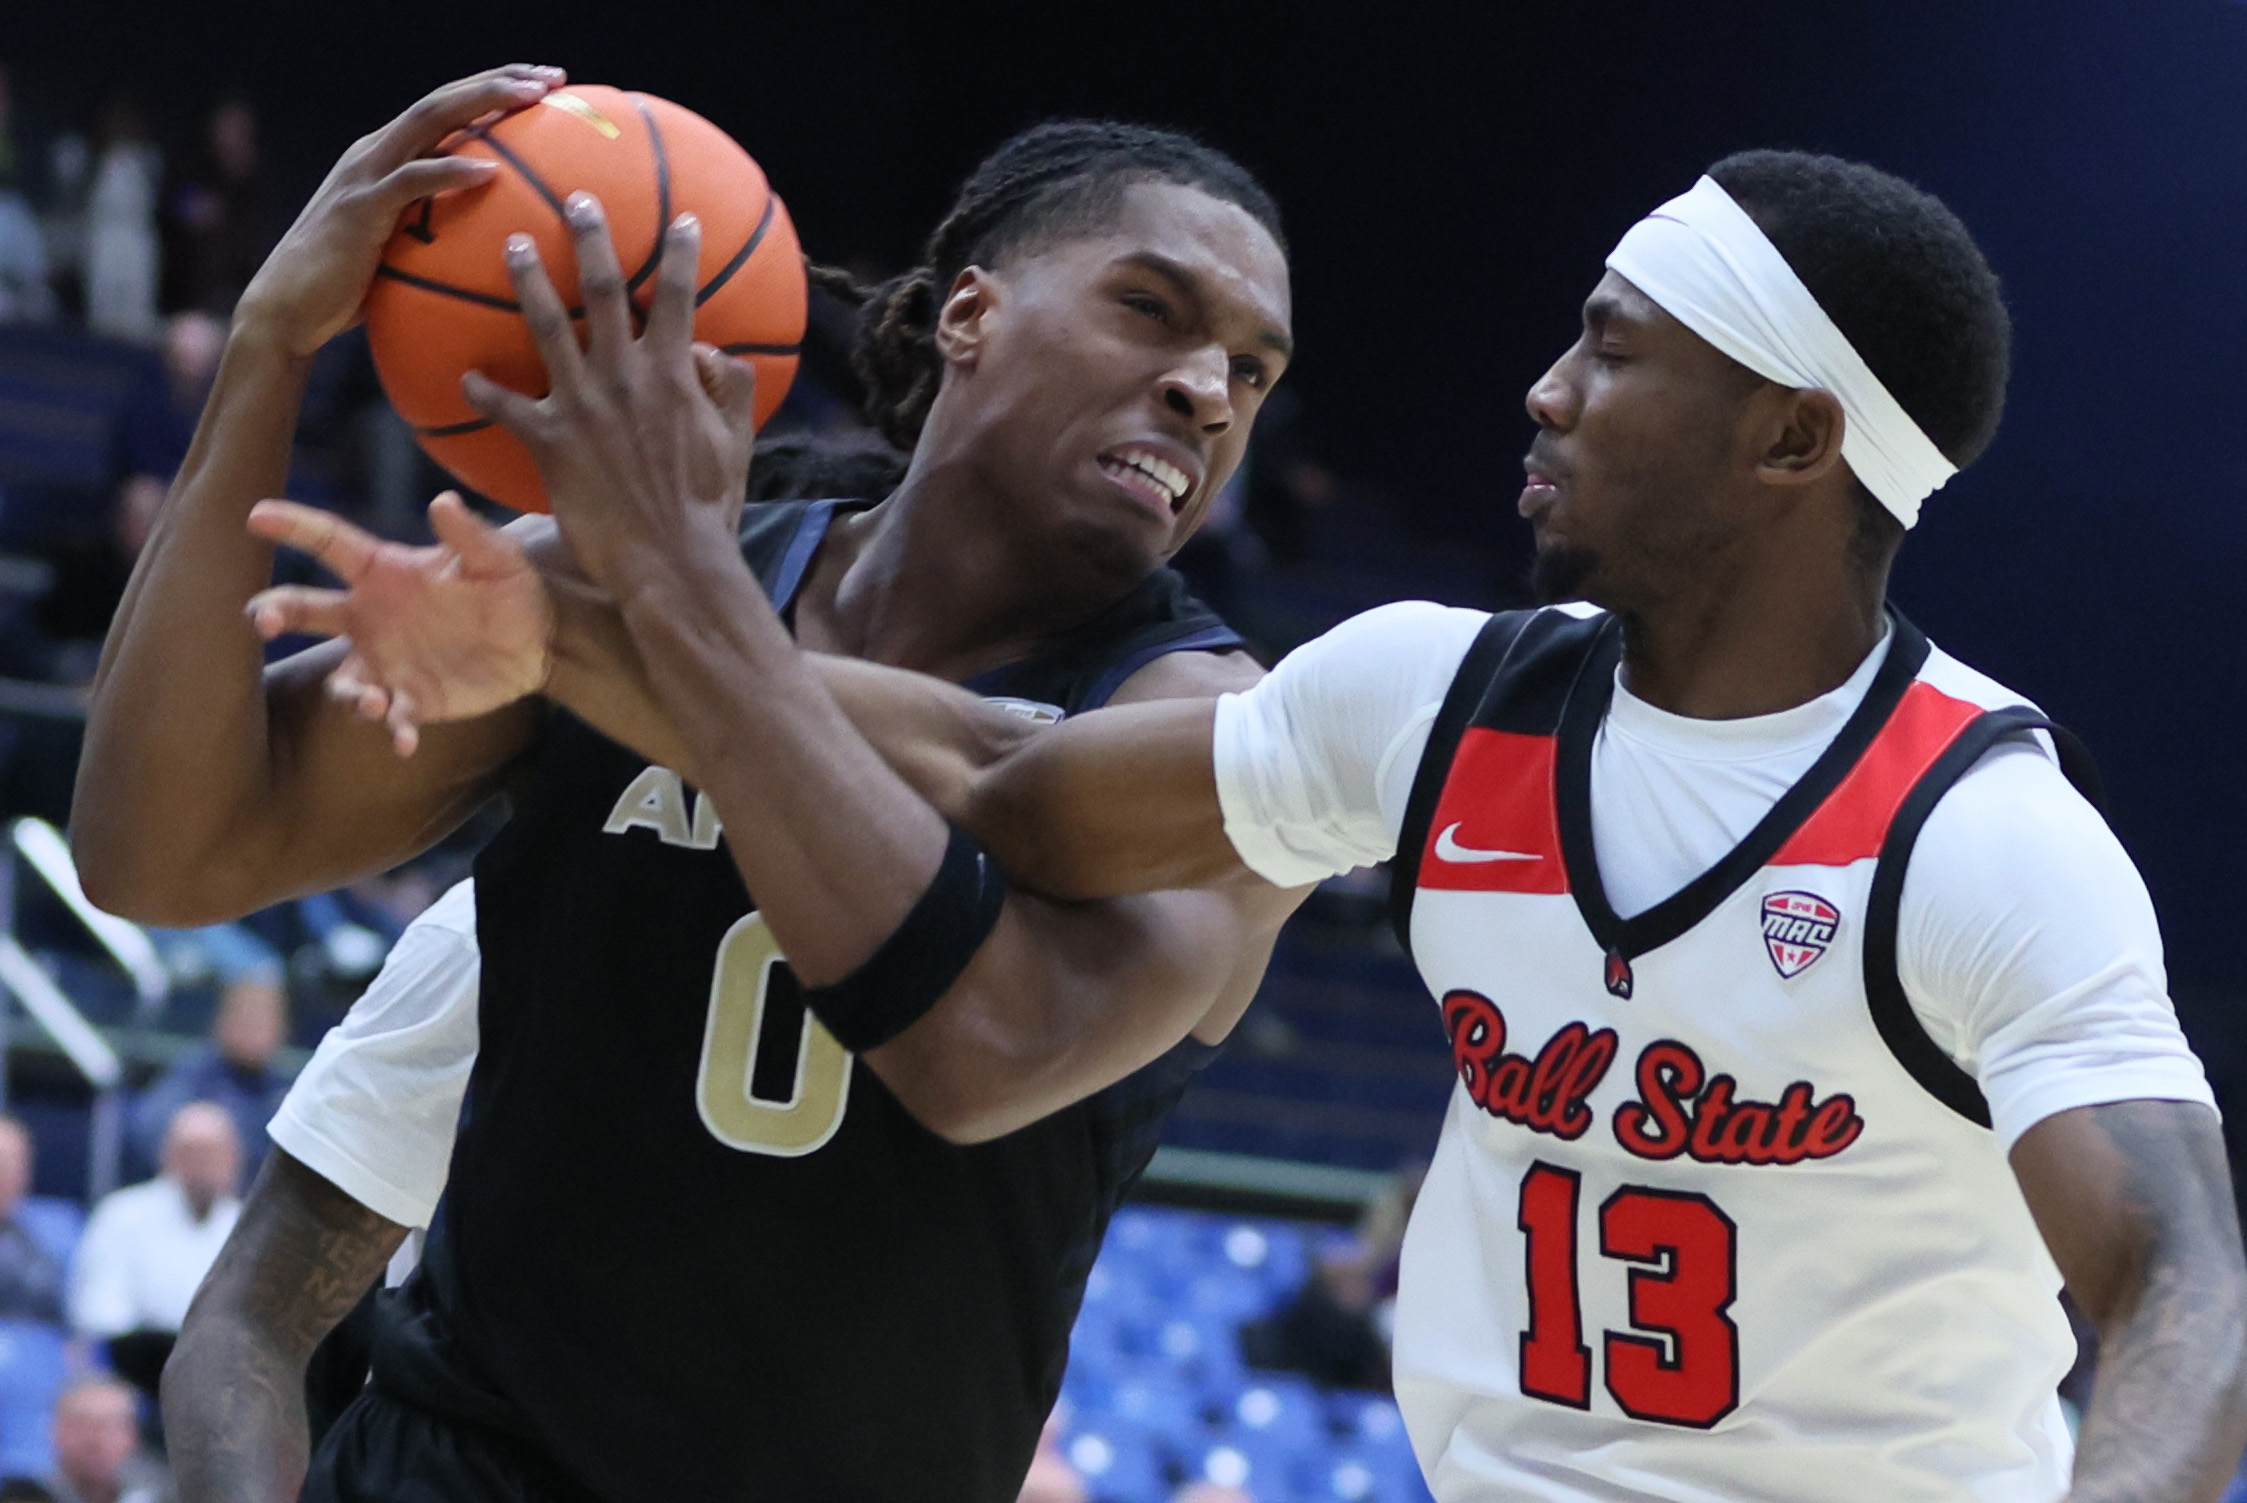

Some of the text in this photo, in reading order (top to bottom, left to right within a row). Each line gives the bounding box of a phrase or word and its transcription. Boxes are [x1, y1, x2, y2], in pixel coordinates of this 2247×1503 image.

[696, 909, 854, 1157] 0
[1762, 914, 1833, 947] MAC
[1441, 988, 1865, 1166] Ball State
[1517, 1158, 1740, 1430] 13
